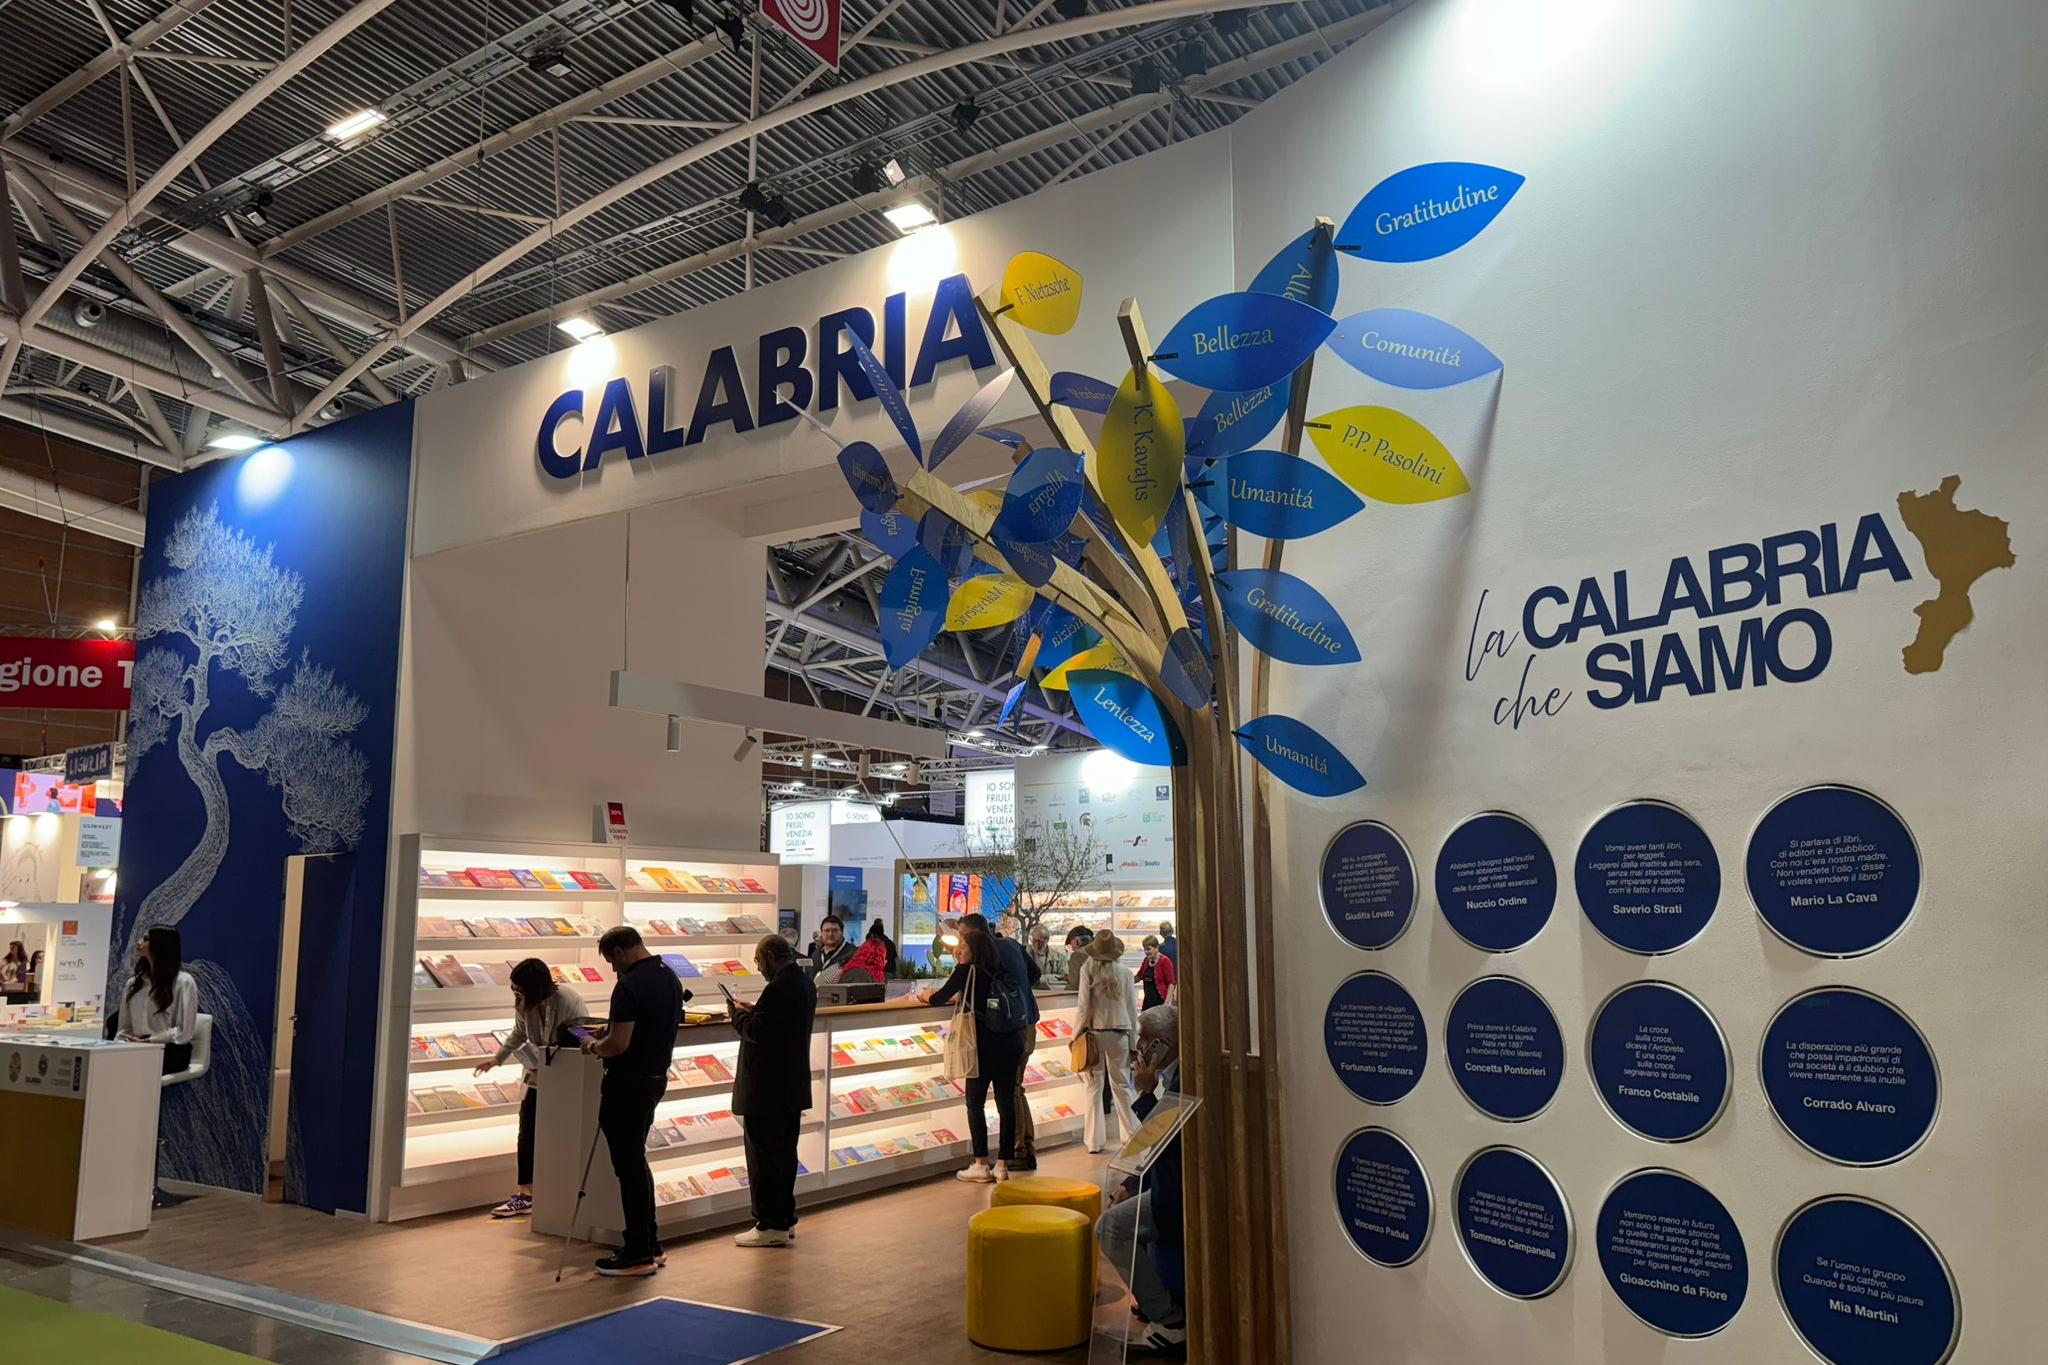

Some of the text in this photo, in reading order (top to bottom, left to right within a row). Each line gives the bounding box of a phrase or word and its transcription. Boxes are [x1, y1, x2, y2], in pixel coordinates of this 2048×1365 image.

[1375, 184, 1499, 236] Gratitudine
[1024, 271, 1070, 302] Nietzsche
[1283, 263, 1313, 301] Alle
[1193, 326, 1274, 355] Bellezza
[1361, 331, 1462, 367] Comunitá
[538, 272, 996, 479] CALABRIA
[1213, 386, 1272, 433] Bellezza
[1128, 431, 1157, 501] Kavafis
[1342, 424, 1447, 485] P.P. Pasolini
[1230, 478, 1314, 510] Umanitá
[881, 508, 902, 536] legria
[1465, 511, 1913, 682] la CALABRIA
[1247, 588, 1342, 653] Gratitudine
[1493, 607, 1833, 731] che SIAMO
[1093, 687, 1156, 743] Lentezza
[1265, 735, 1328, 775] Umanitá
[987, 783, 996, 791] IO
[987, 794, 1010, 802] FRIULI
[986, 805, 1014, 814] VENEZ
[1788, 878, 1812, 886] volete
[1815, 875, 1848, 884] vendere
[1858, 872, 1883, 880] libro?
[1466, 897, 1528, 909] Nuccio Ordine
[1613, 904, 1682, 914] Saverio Strati
[1791, 893, 1878, 906] Mario La Cava
[1790, 1051, 1805, 1059] che
[1808, 1052, 1832, 1061] possa
[1835, 1055, 1888, 1063] impadronirsi
[1799, 1042, 1852, 1052] disperazione
[1854, 1044, 1868, 1053] più
[1871, 1046, 1902, 1054] grande
[1341, 1062, 1413, 1075] Fortunato Seminara
[1465, 1062, 1546, 1076] Concetta Pontorieri
[1815, 1072, 1861, 1081] rettamente
[1864, 1075, 1876, 1083] sia
[1879, 1076, 1905, 1084] inutile
[1854, 1065, 1884, 1073] dubbio
[1619, 1085, 1699, 1102] Franco Costabile
[1803, 1097, 1895, 1113] Corrado Alvaro
[1469, 1229, 1556, 1259] Tommaso Campanella
[1817, 1257, 1828, 1266] Se
[1830, 1259, 1860, 1273] l'uomo
[1873, 1269, 1905, 1281] gruppo
[1841, 1273, 1854, 1282] più
[1856, 1277, 1888, 1288] cattivo.
[1620, 1273, 1727, 1300] Gioacchino da Fiore
[1803, 1274, 1924, 1306] Quando è solo ha più paura
[1830, 1299, 1898, 1324] Mia Martini
